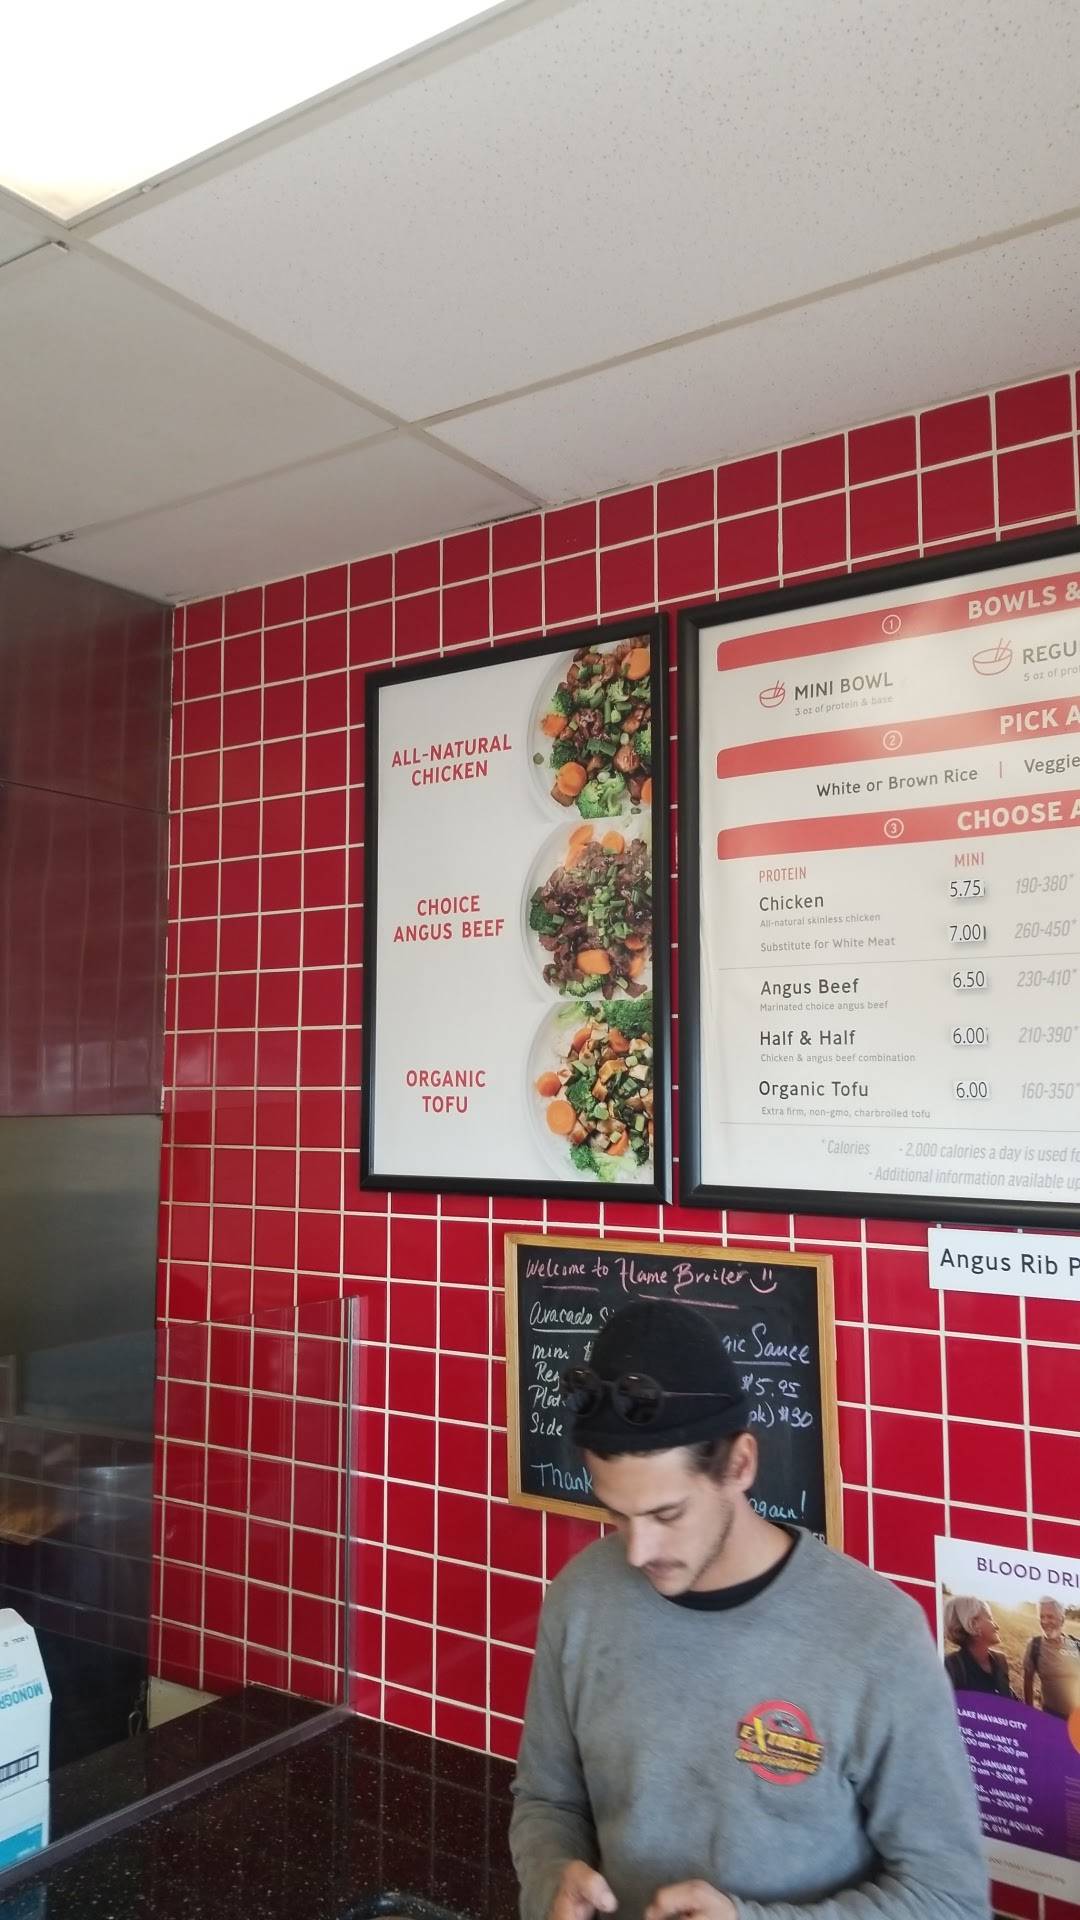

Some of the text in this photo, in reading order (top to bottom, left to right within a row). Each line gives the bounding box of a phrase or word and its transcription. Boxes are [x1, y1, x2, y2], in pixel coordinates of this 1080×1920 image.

[967, 585, 1057, 620] BOWLS
[1022, 640, 1077, 665] REGU
[1024, 672, 1030, 681] 5
[1033, 672, 1044, 680] oz
[1047, 668, 1057, 678] of
[795, 671, 893, 700] MINI BOWL
[795, 708, 801, 716] 3
[815, 704, 824, 713] of
[826, 700, 858, 713] protein
[871, 696, 894, 705] base
[1000, 707, 1058, 735] PICK
[391, 734, 512, 768] ALL-NATURAL
[411, 760, 488, 786] CHICKEN
[1024, 754, 1080, 774] Veggie
[816, 768, 978, 797] White or Brown Rice
[957, 801, 1063, 831] CHOOSE
[954, 852, 984, 867] MINI
[759, 866, 807, 883] PROTEIN
[950, 880, 981, 897] 5.75
[417, 895, 480, 916] CHOICE
[759, 894, 824, 911] Chicken
[393, 918, 505, 942] ANGUS BEEF
[760, 913, 881, 928] All-natural skinless chicken
[949, 924, 981, 941] 7.00
[760, 937, 896, 952] Substitute for White Meat
[760, 978, 859, 998] Angus Beef
[953, 971, 985, 988] 6.50
[760, 1000, 889, 1011] Marinated choice angus beef
[760, 1029, 856, 1046] Half & Half
[953, 1027, 985, 1044] 6.00
[760, 1053, 916, 1064] Chicken & angus beef combination
[406, 1070, 486, 1088] ORGANIC
[759, 1080, 869, 1100] Organic Tofu
[956, 1082, 988, 1098] 6.00
[421, 1095, 468, 1113] TOFU
[761, 1106, 931, 1119] Extra firm, non-gmo, charbroiled tofu
[940, 1144, 986, 1159] calories
[988, 1148, 996, 1160] a
[999, 1146, 1020, 1162] day
[1024, 1146, 1035, 1161] is
[1038, 1147, 1067, 1162] used
[874, 1166, 932, 1184] Additional
[935, 1169, 1005, 1186] information
[1008, 1172, 1065, 1190] available
[940, 1248, 1080, 1276] Angus Rib P
[526, 1256, 749, 1296] Welcome to Flame Broiler
[751, 1322, 811, 1365] Sauce
[530, 1411, 562, 1437] Side
[530, 1462, 594, 1495] Thank
[977, 1557, 1080, 1588] BLOOD DRI
[957, 1708, 976, 1719] LAKE
[1009, 1720, 1027, 1731] CITY
[975, 1730, 1013, 1745] JANUARY
[980, 1758, 1018, 1774] JANUARY
[989, 1787, 1026, 1802] JANUARY
